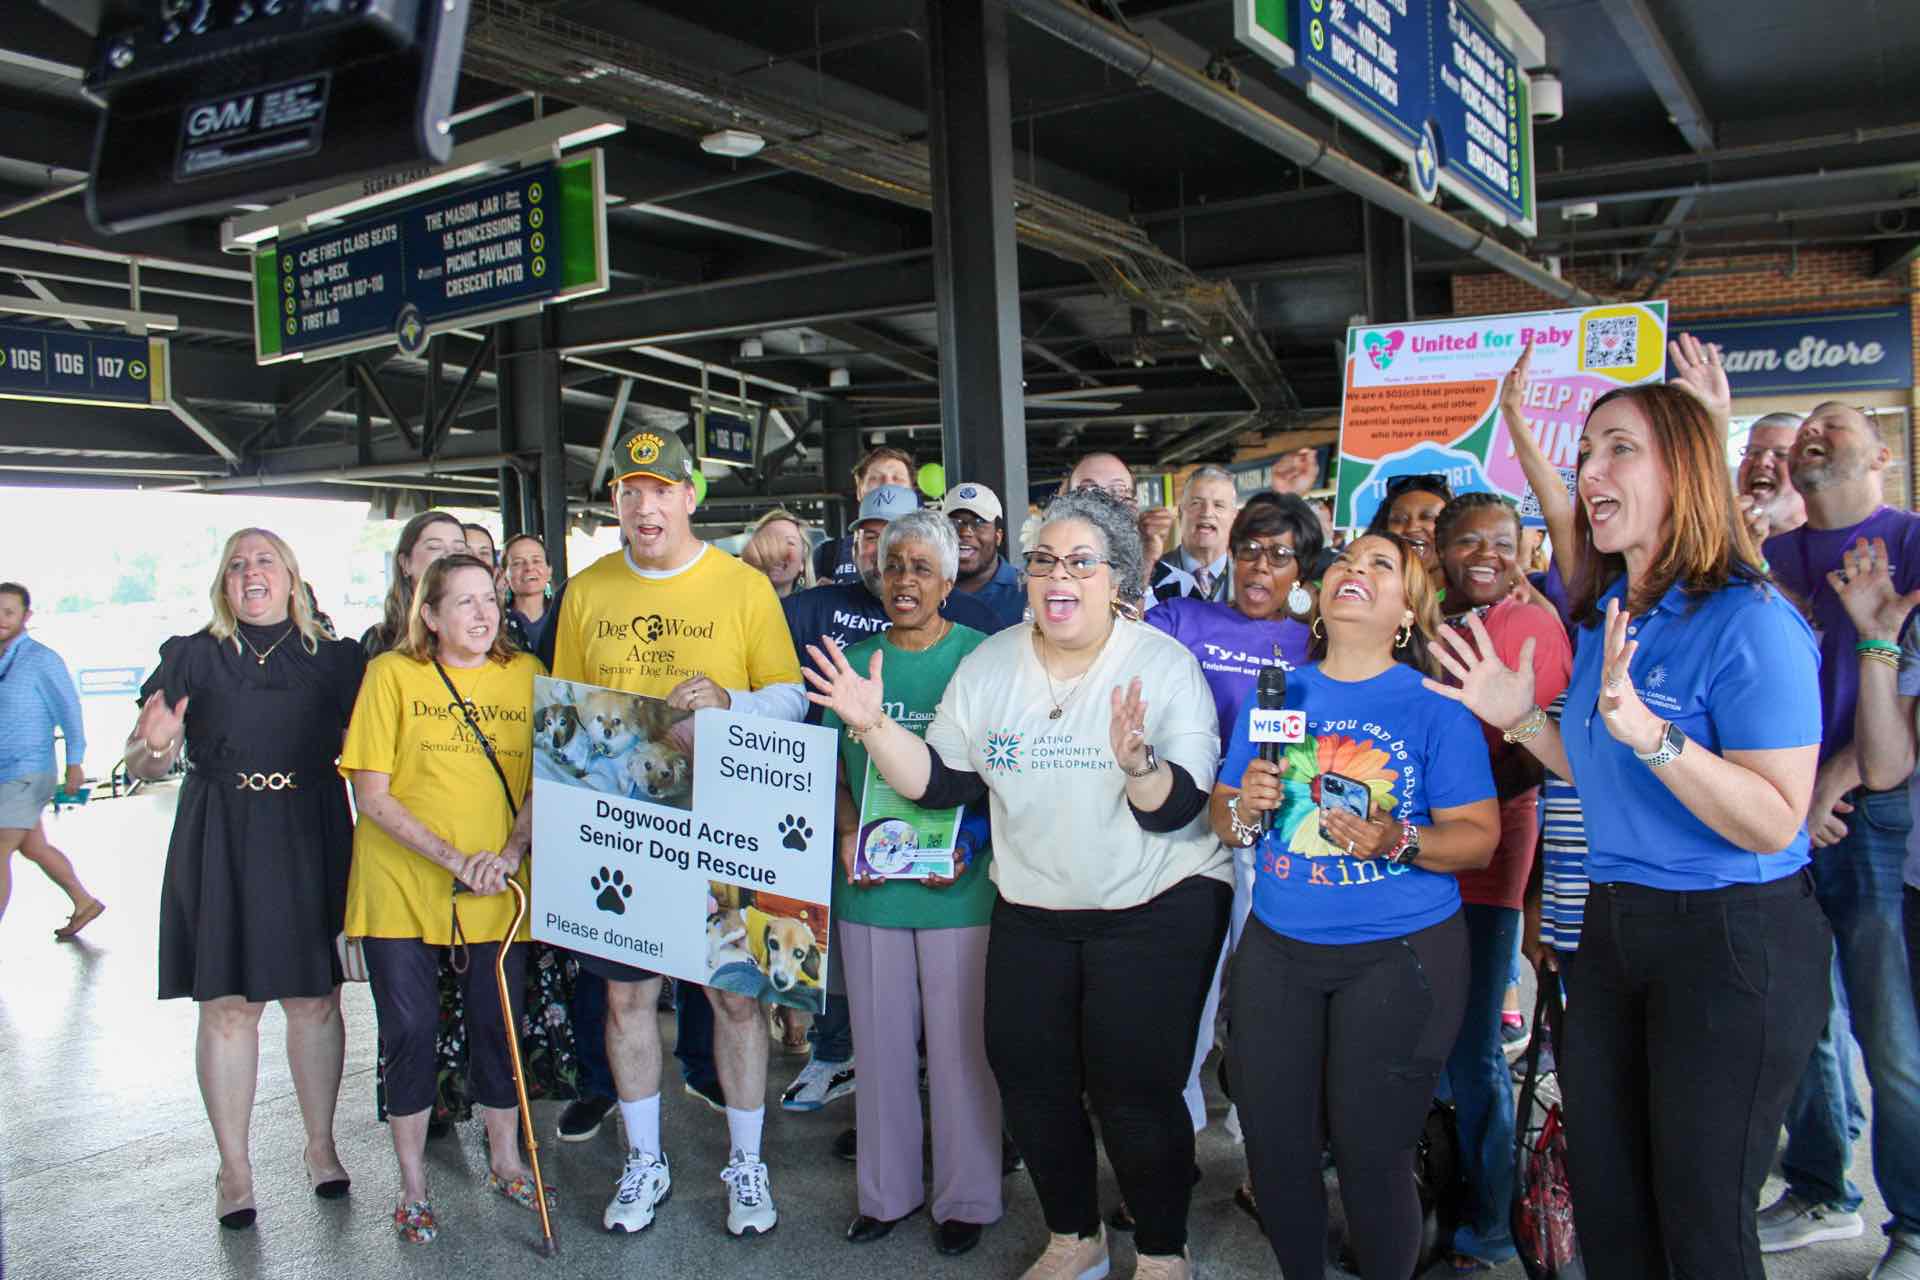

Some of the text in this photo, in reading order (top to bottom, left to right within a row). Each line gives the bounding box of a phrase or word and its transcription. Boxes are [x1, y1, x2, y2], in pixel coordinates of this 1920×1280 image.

[189, 96, 255, 136] GVM
[425, 212, 443, 232] THE
[445, 201, 479, 226] MASON
[480, 195, 500, 216] JAR
[455, 214, 521, 247] CONCESSIONS
[320, 240, 342, 262] FIRST
[343, 232, 369, 254] CLASS
[371, 224, 398, 246] SEATS
[446, 250, 477, 274] PICNIC
[479, 239, 522, 265] PAVILION
[446, 270, 494, 298] CRESCENT
[495, 264, 524, 286] PATIO
[315, 283, 353, 308] ALL-STAR
[302, 308, 340, 332] FIRST AID
[1411, 326, 1574, 353] United for Baby
[10, 348, 42, 371] 105
[55, 352, 84, 375] 106
[1784, 336, 1886, 372] Store
[97, 356, 124, 379] 107
[1422, 388, 1441, 397] that
[1444, 386, 1486, 398] provides
[1431, 401, 1449, 409] and
[1451, 400, 1477, 409] other
[1349, 415, 1478, 427] essential supplies to people
[1371, 430, 1390, 439] who
[1392, 429, 1414, 438] have
[598, 618, 714, 640] Dog Wood
[626, 644, 675, 663] Acres
[599, 663, 634, 675] Senior
[640, 664, 662, 677] Dog
[412, 701, 527, 722] Dog Wood
[1254, 720, 1281, 733] WIS
[728, 725, 806, 764] Saving
[1032, 735, 1073, 745] LATINO
[1323, 719, 1358, 733] you
[1362, 722, 1392, 742] can
[1390, 740, 1409, 760] be
[1031, 747, 1103, 757] COMMUNITY
[720, 756, 812, 793] Seniors!
[1031, 759, 1113, 770] DEVELOPMENT
[596, 799, 759, 852] Dogwood Acres
[579, 824, 777, 885] Senior Dog Rescue
[546, 912, 664, 958] Please donate!
